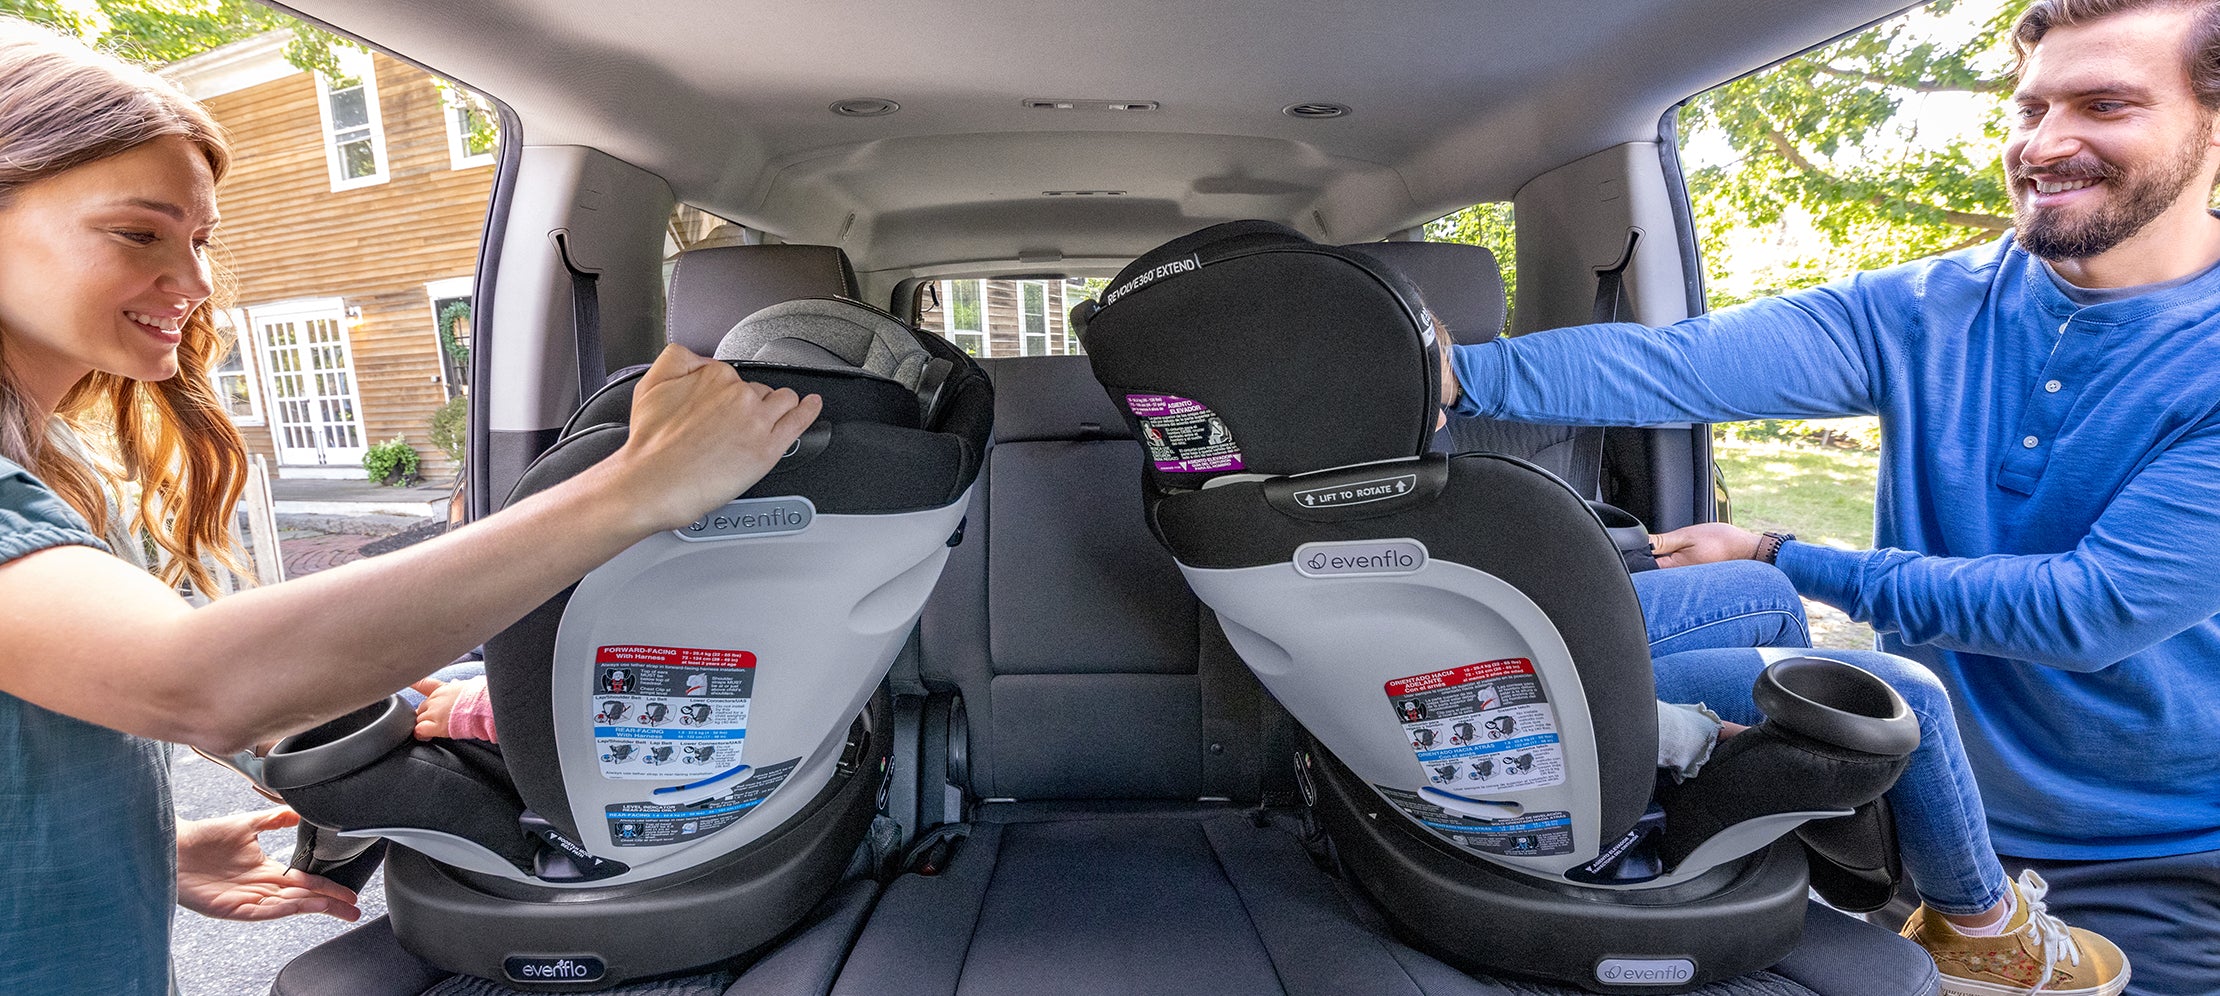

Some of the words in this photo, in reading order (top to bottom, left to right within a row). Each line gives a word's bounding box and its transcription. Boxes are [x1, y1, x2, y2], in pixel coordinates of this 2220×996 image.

[1156, 259, 1195, 278] EXTEND
[1168, 400, 1192, 409] ASIENTO
[1170, 405, 1201, 415] ELEVADOR
[1319, 494, 1336, 502] LIFT
[1340, 491, 1352, 499] TO
[1357, 485, 1391, 497] ROTATE
[714, 507, 802, 530] evenflo
[1331, 550, 1413, 569] evenflo
[604, 647, 676, 655] FORWARD-FACING
[1390, 675, 1430, 686] ORIENTADO
[1406, 678, 1442, 688] ADELANTE
[522, 960, 587, 977] evenflo
[1623, 965, 1687, 980] evenflo
